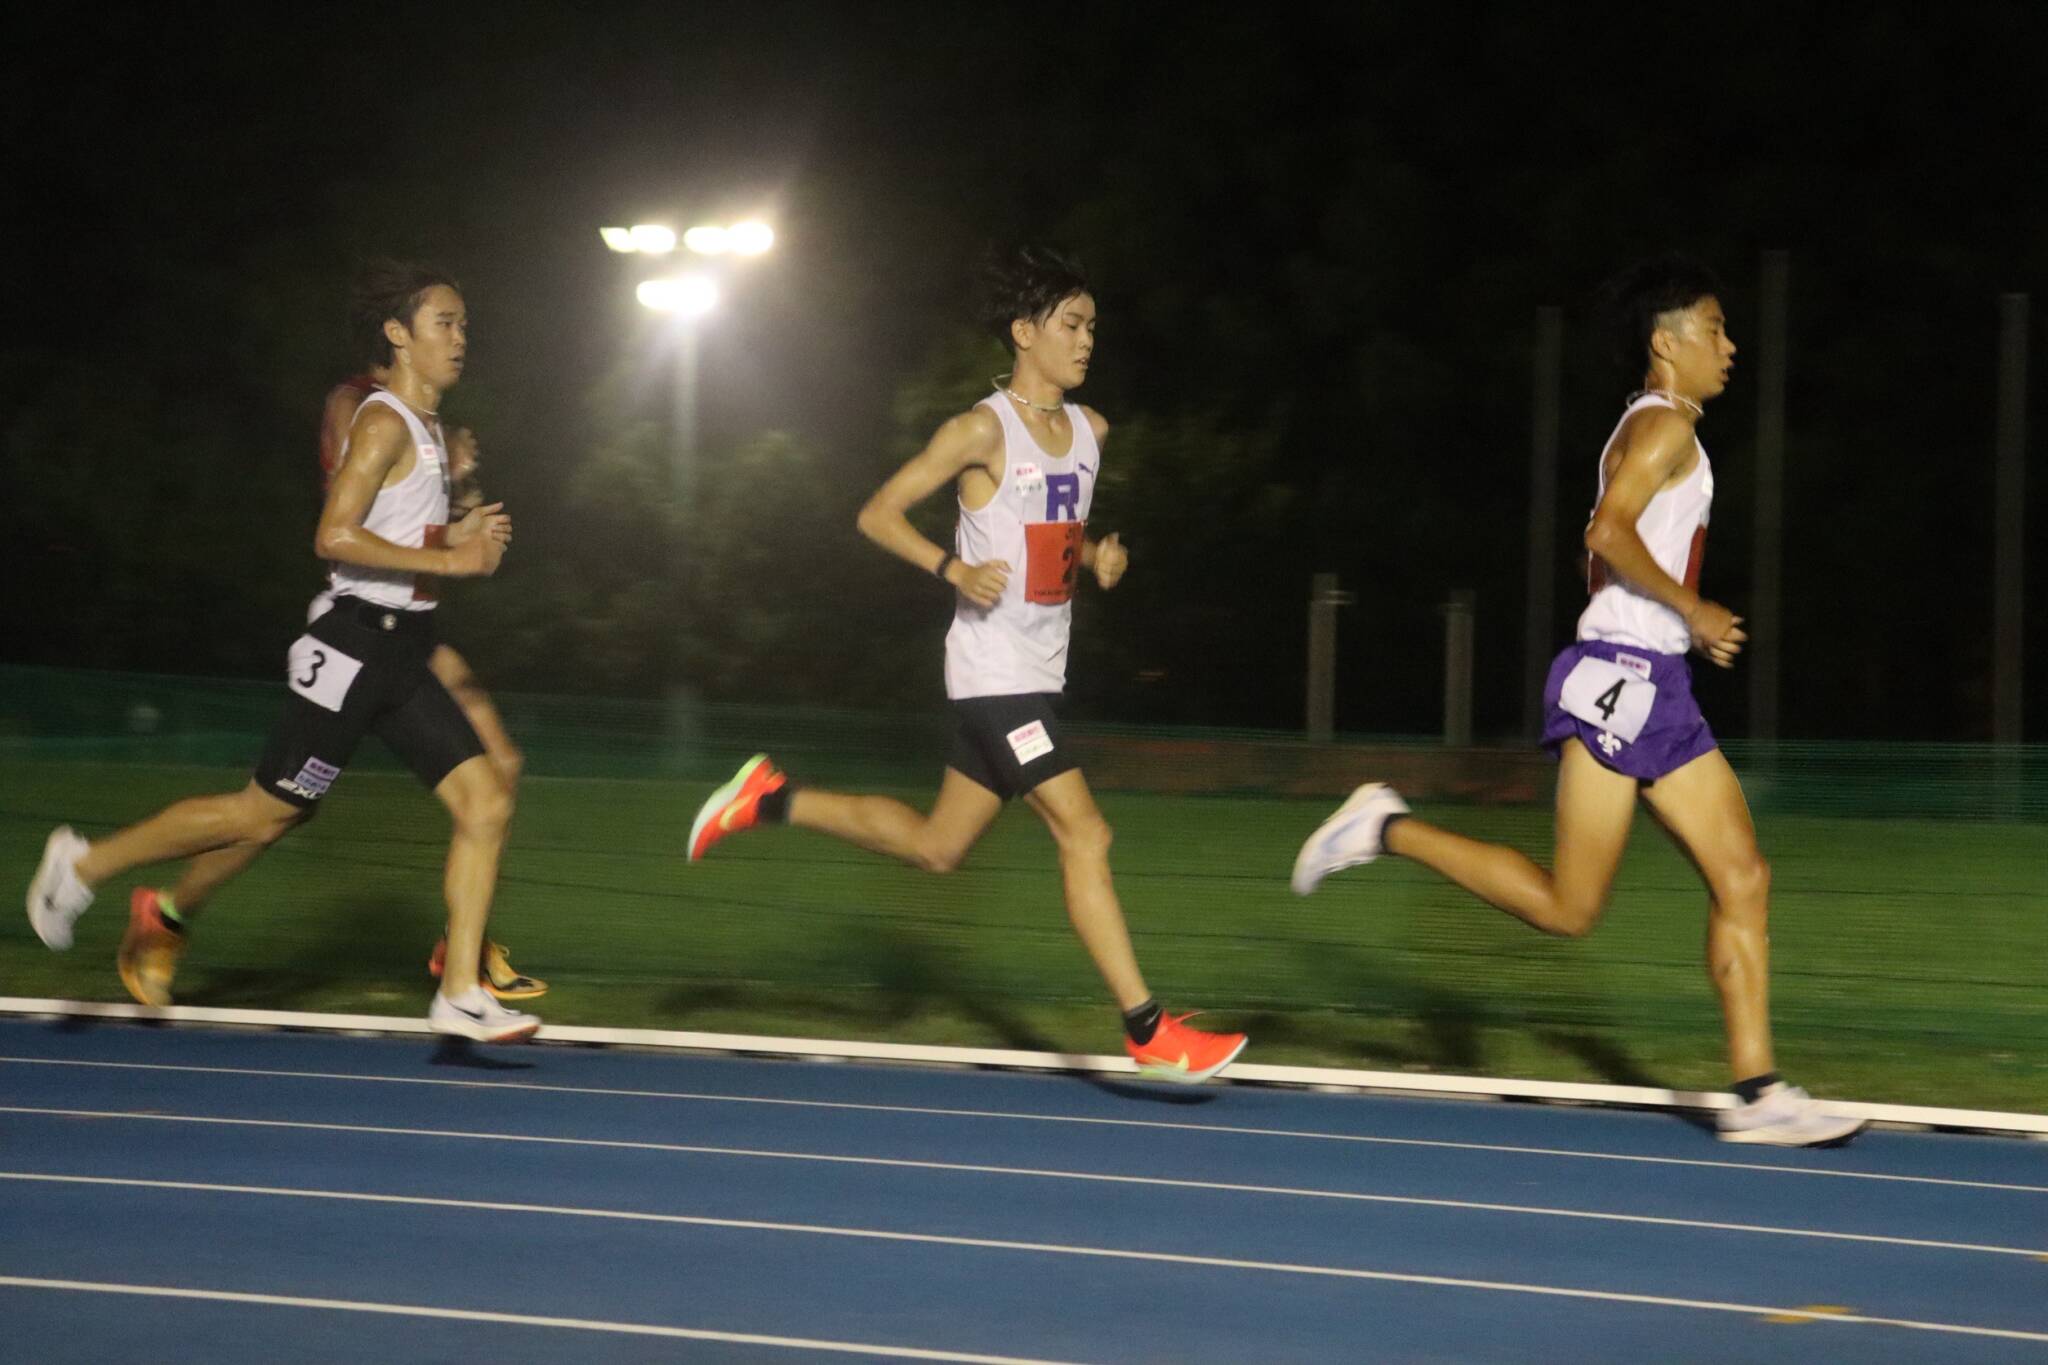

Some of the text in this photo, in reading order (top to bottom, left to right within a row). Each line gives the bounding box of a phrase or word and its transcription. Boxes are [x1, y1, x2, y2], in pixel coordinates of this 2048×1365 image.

[1046, 473, 1080, 521] R
[1062, 546, 1075, 584] 2
[297, 650, 326, 688] 3
[1594, 678, 1626, 721] 4
